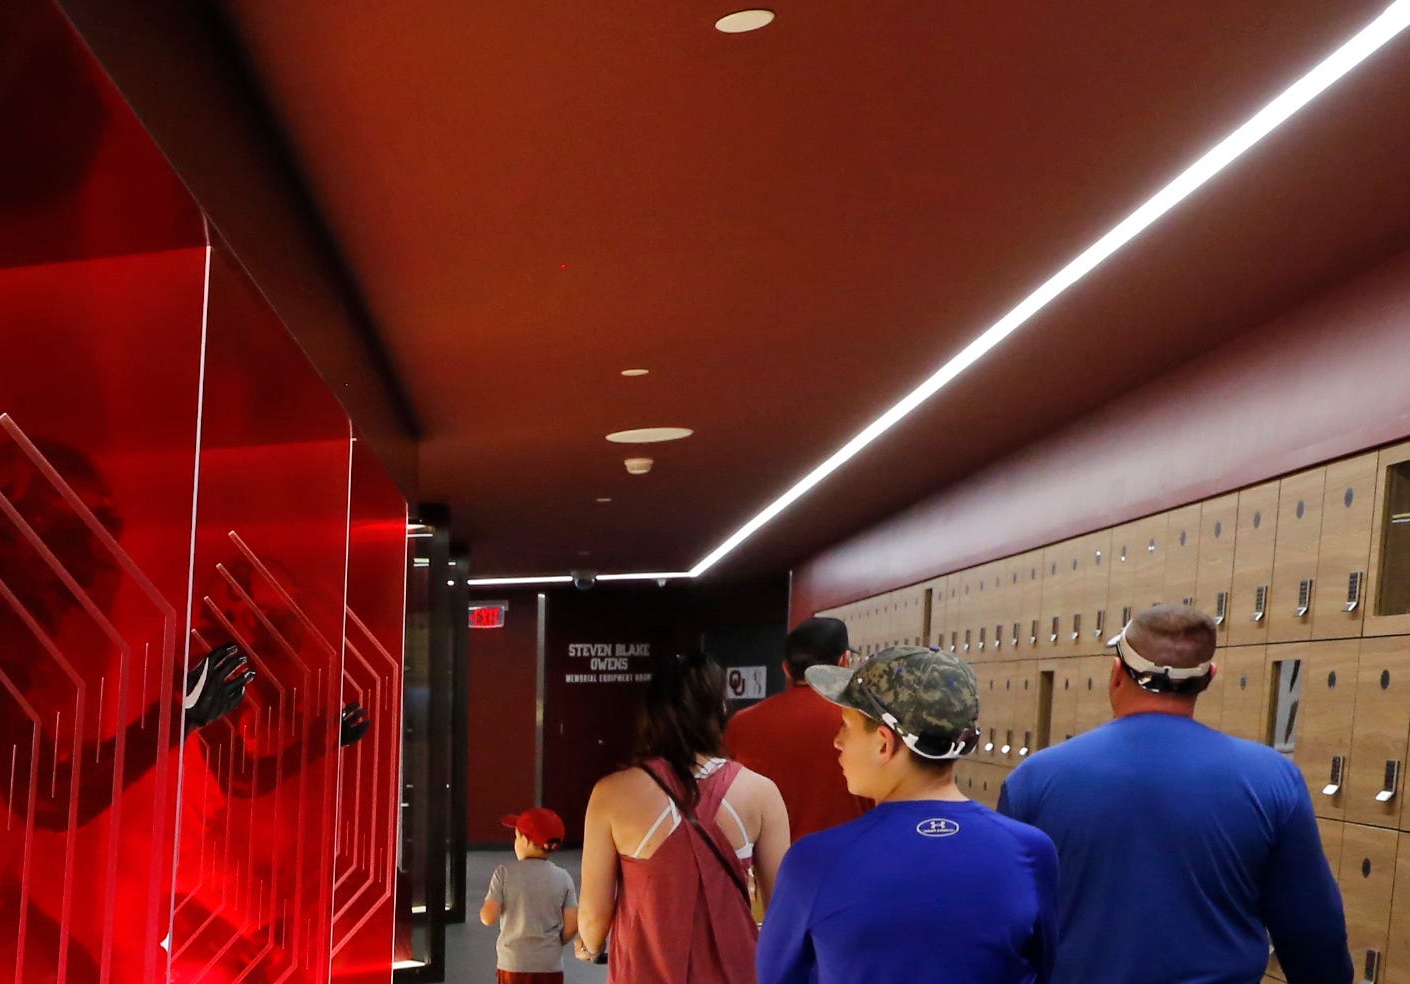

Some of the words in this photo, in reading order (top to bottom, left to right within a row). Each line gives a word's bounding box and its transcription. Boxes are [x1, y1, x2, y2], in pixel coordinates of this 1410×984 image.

[569, 644, 612, 657] STEVEN
[615, 644, 651, 657] BLAKE
[590, 658, 628, 671] OWENS
